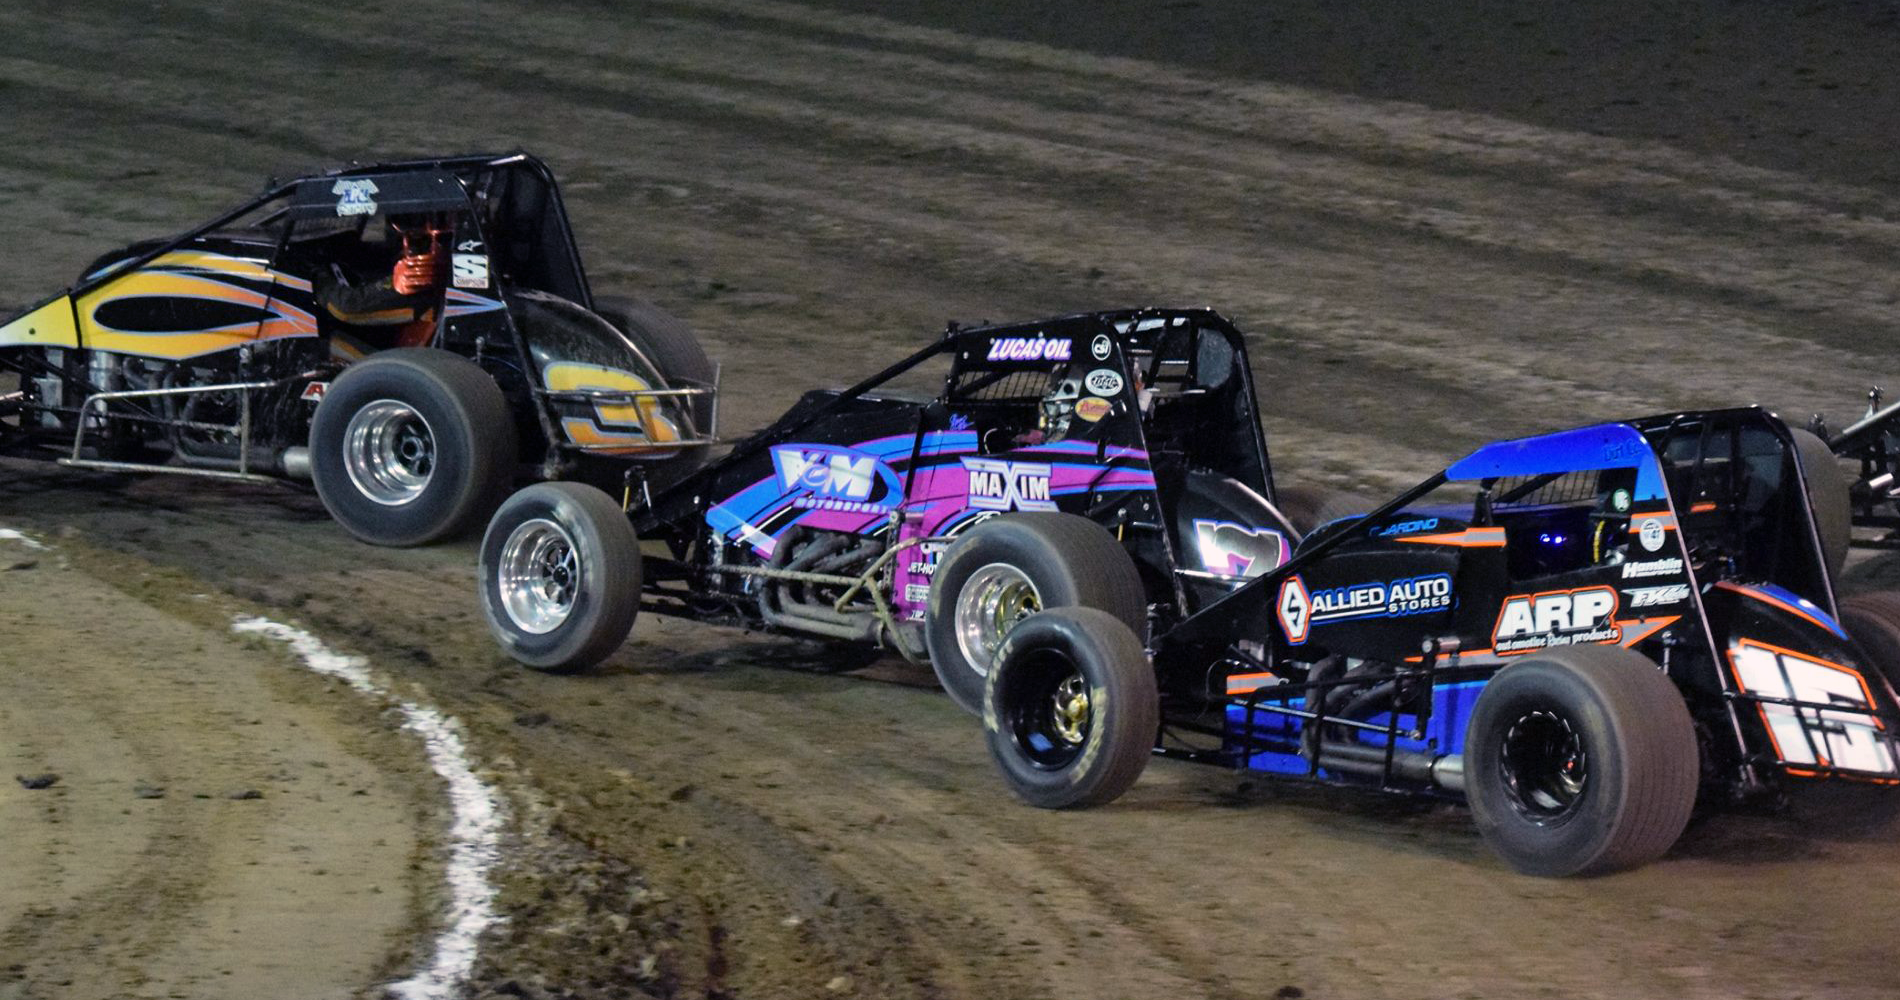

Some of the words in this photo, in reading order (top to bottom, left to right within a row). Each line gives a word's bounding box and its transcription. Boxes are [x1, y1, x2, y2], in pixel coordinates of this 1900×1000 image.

[987, 338, 1044, 361] LUCAS
[1044, 338, 1073, 361] OIL
[543, 361, 680, 460] 3
[969, 459, 1052, 512] MAXIM
[1311, 587, 1386, 614] ALLIED
[1389, 577, 1450, 604] AUTO
[1388, 595, 1451, 613] STORES
[1496, 591, 1615, 638] ARP
[1571, 628, 1619, 645] products
